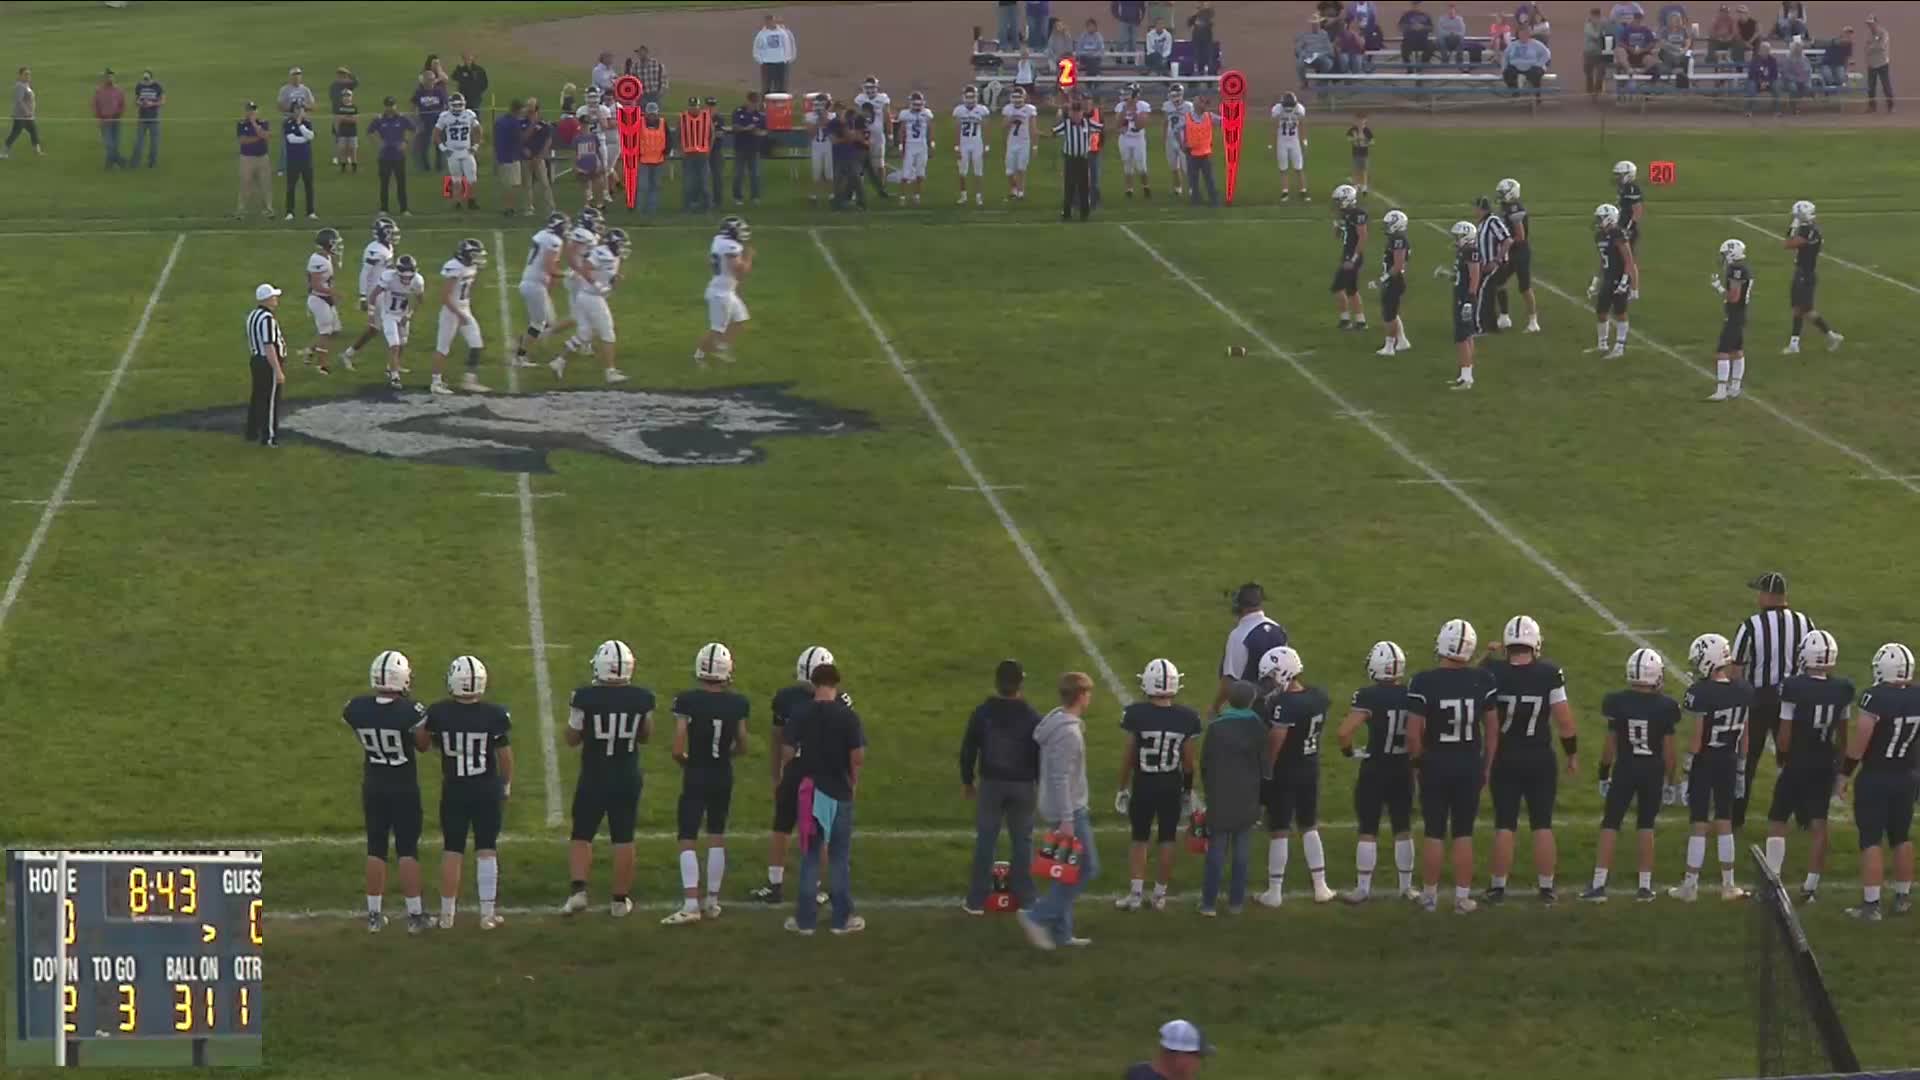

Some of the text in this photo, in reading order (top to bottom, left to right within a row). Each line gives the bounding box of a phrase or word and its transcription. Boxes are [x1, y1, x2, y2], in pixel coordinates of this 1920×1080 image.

[1059, 59, 1073, 83] 2
[449, 126, 469, 141] 22
[911, 122, 921, 138] 5
[961, 122, 977, 136] 21
[1012, 119, 1022, 136] 7
[1281, 121, 1297, 136] 12
[1651, 165, 1672, 183] 20
[1439, 699, 1475, 742] 31
[1498, 695, 1543, 737] 77
[1707, 705, 1750, 753] 24
[1813, 703, 1835, 741] 4
[357, 727, 408, 766] 99
[594, 712, 641, 756] 44
[712, 719, 723, 759] 1
[1886, 715, 1920, 758] 17
[442, 731, 488, 777] 40
[1139, 731, 1186, 773] 20
[29, 868, 77, 893] HOE
[223, 869, 262, 894] GUES
[1050, 864, 1064, 878] G
[129, 867, 196, 913] 8:43
[997, 896, 1009, 908] G
[92, 956, 136, 981] TO GO
[166, 957, 219, 981] BALL ON
[234, 957, 262, 981] QTR
[118, 984, 136, 1031] 3
[175, 984, 214, 1031] 31
[240, 987, 249, 1025] 1
